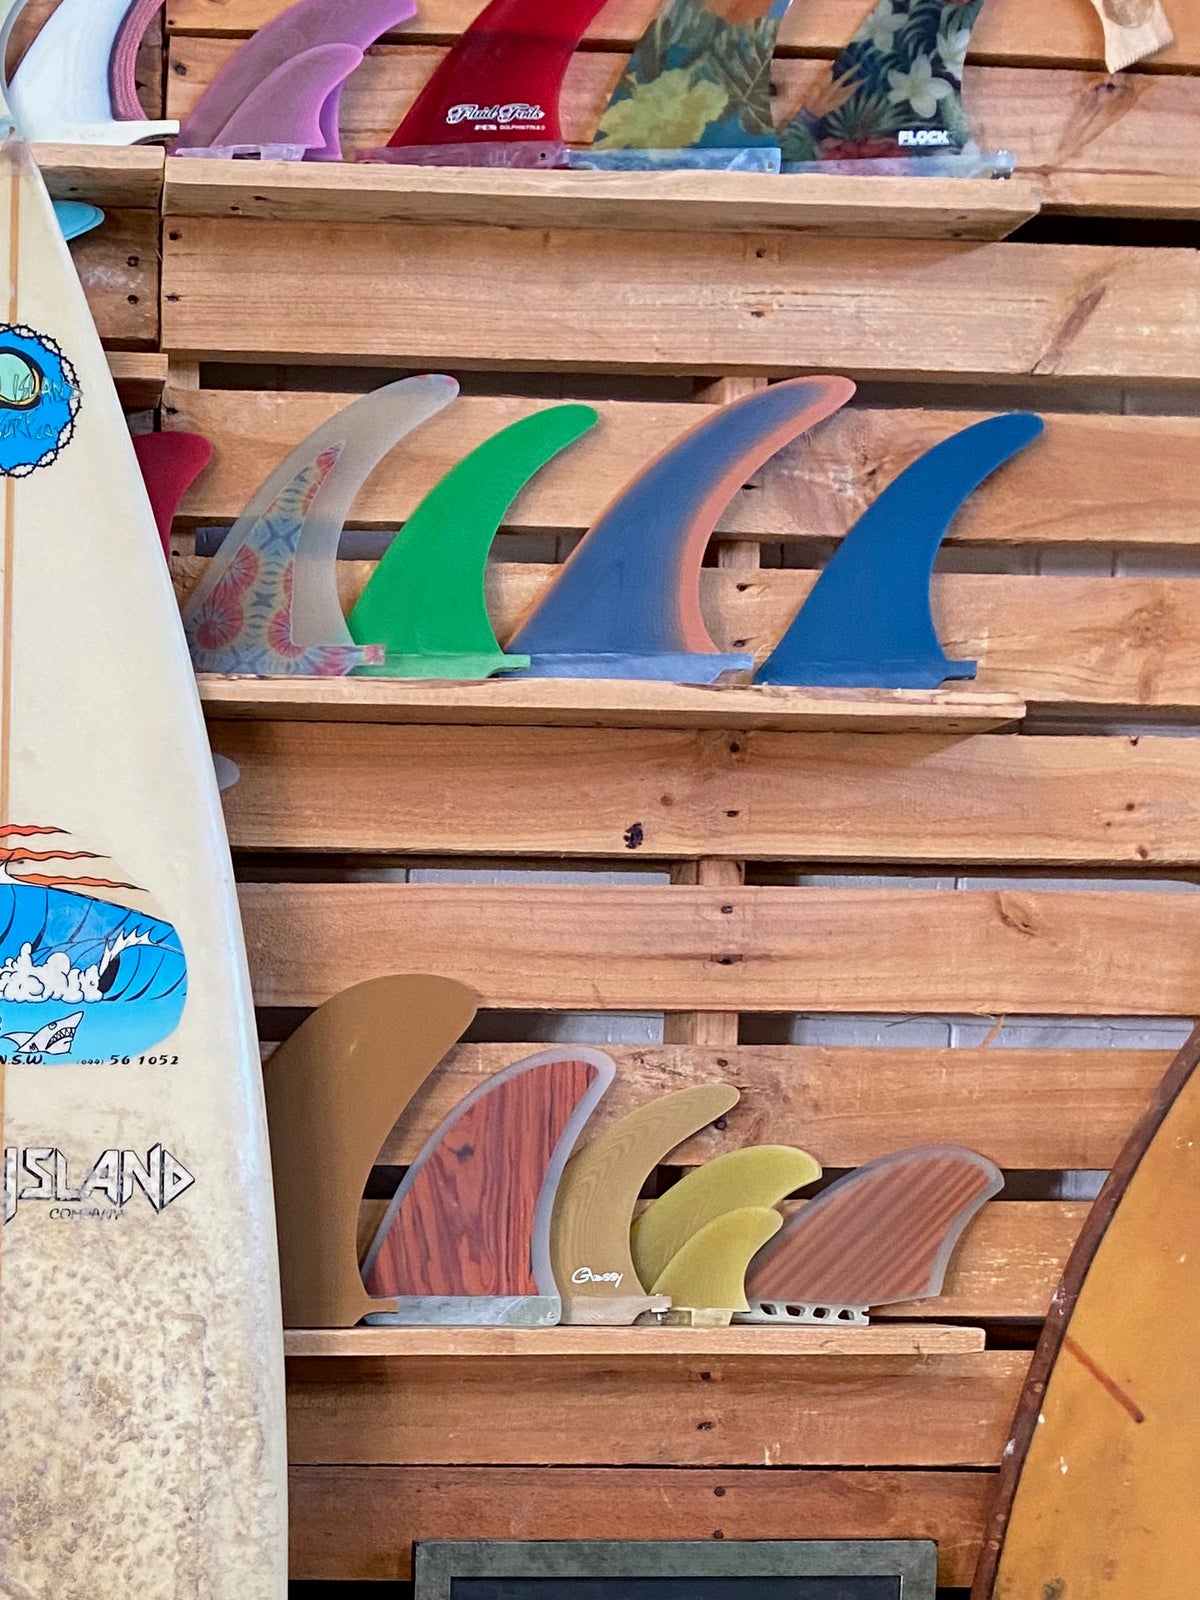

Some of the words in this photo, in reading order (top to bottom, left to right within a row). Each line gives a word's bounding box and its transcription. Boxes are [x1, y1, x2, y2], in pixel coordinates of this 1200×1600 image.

[446, 104, 500, 124] Fluid
[898, 130, 950, 146] FLOCK
[12, 373, 84, 405] ISLAND
[109, 1054, 131, 1066] 56
[138, 1055, 179, 1066] 1052
[3, 1142, 196, 1226] ISLAND
